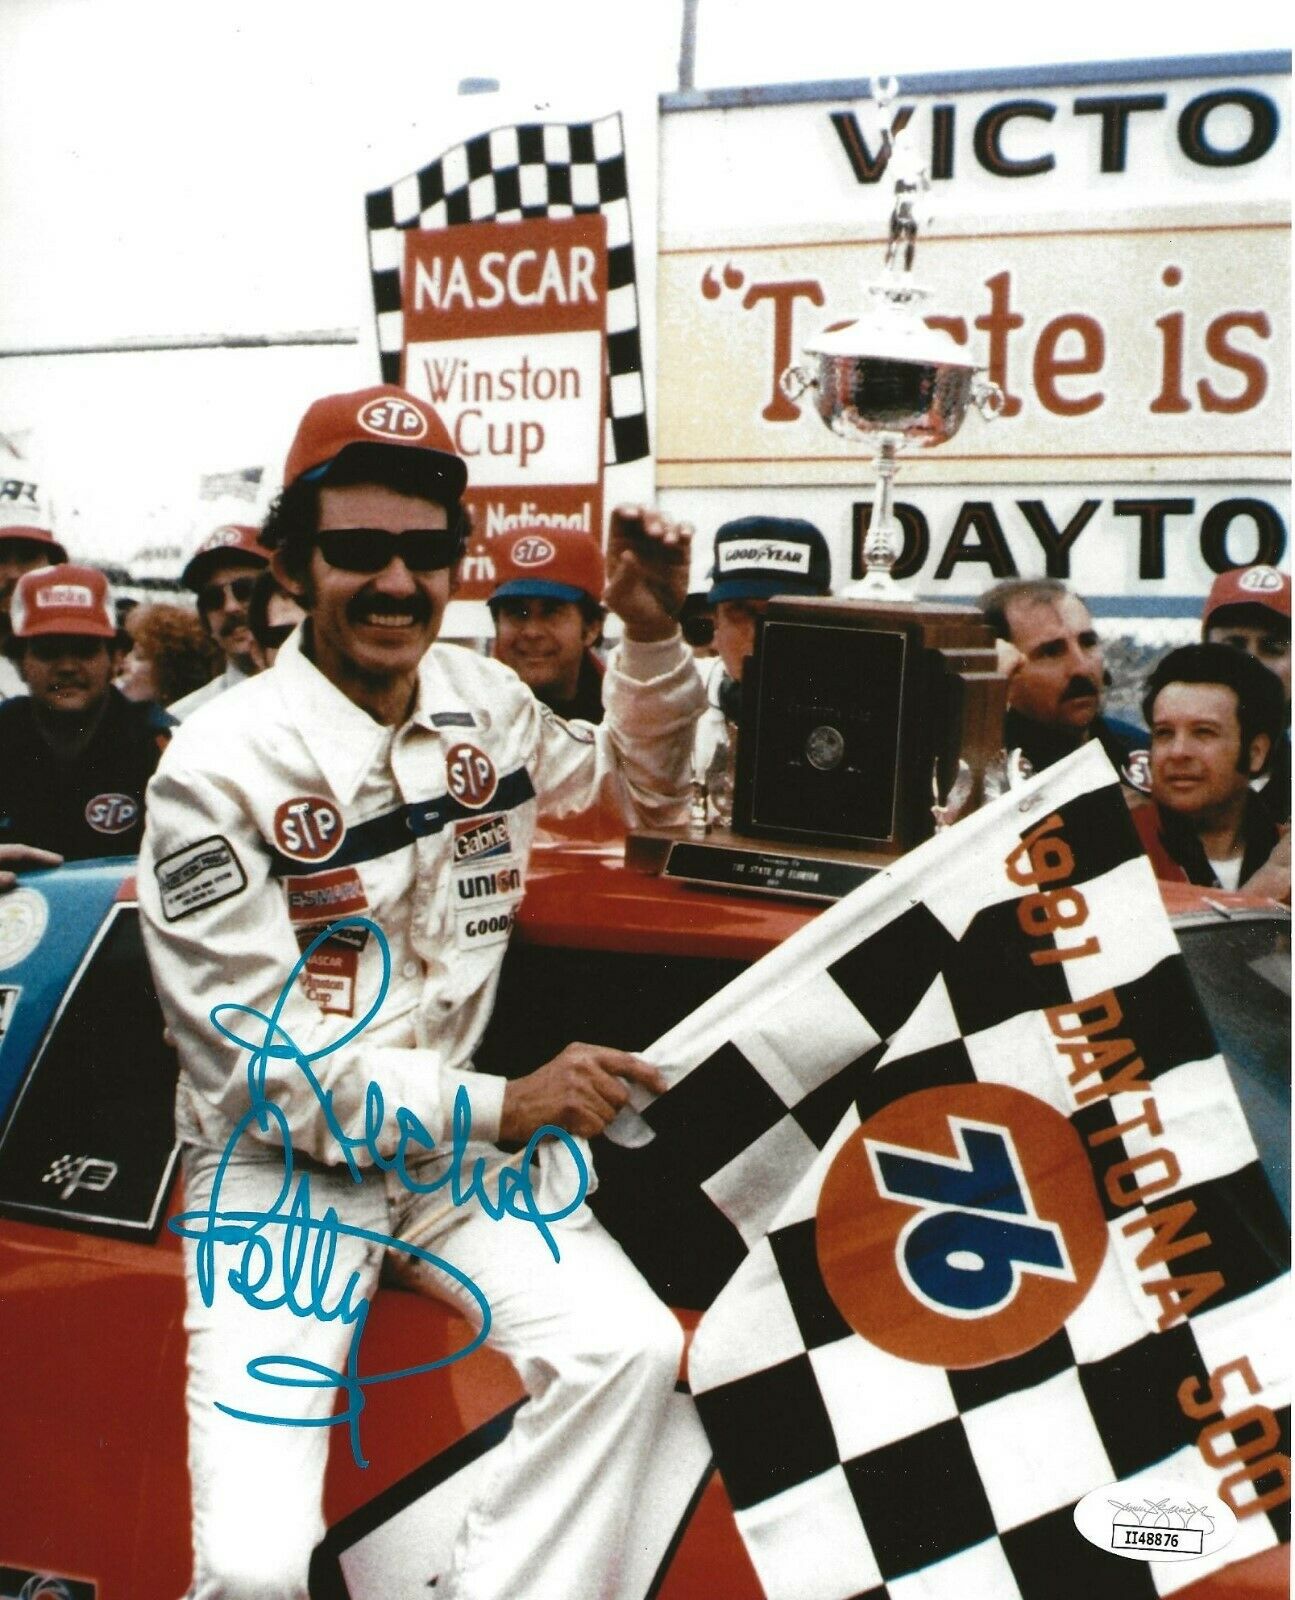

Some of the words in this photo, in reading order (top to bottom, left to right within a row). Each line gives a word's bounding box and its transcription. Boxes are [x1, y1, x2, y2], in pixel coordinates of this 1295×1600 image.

[828, 88, 1281, 185] VICTO
[413, 246, 599, 311] NASCAR
[1149, 264, 1272, 415] is
[423, 355, 581, 403] Winston
[368, 401, 420, 431] STP
[454, 408, 546, 468] Cup
[485, 501, 591, 539] National
[515, 539, 549, 561] STP
[850, 497, 1289, 582] DAYTO
[450, 748, 490, 796] STP
[89, 798, 136, 828] STP
[281, 801, 337, 851] STP
[1004, 813, 1103, 966] 1981
[1043, 988, 1226, 1333] DAYTONA
[863, 1115, 1077, 1320] 76
[1176, 1354, 1292, 1522] 500
[1124, 1530, 1179, 1548] II48876
